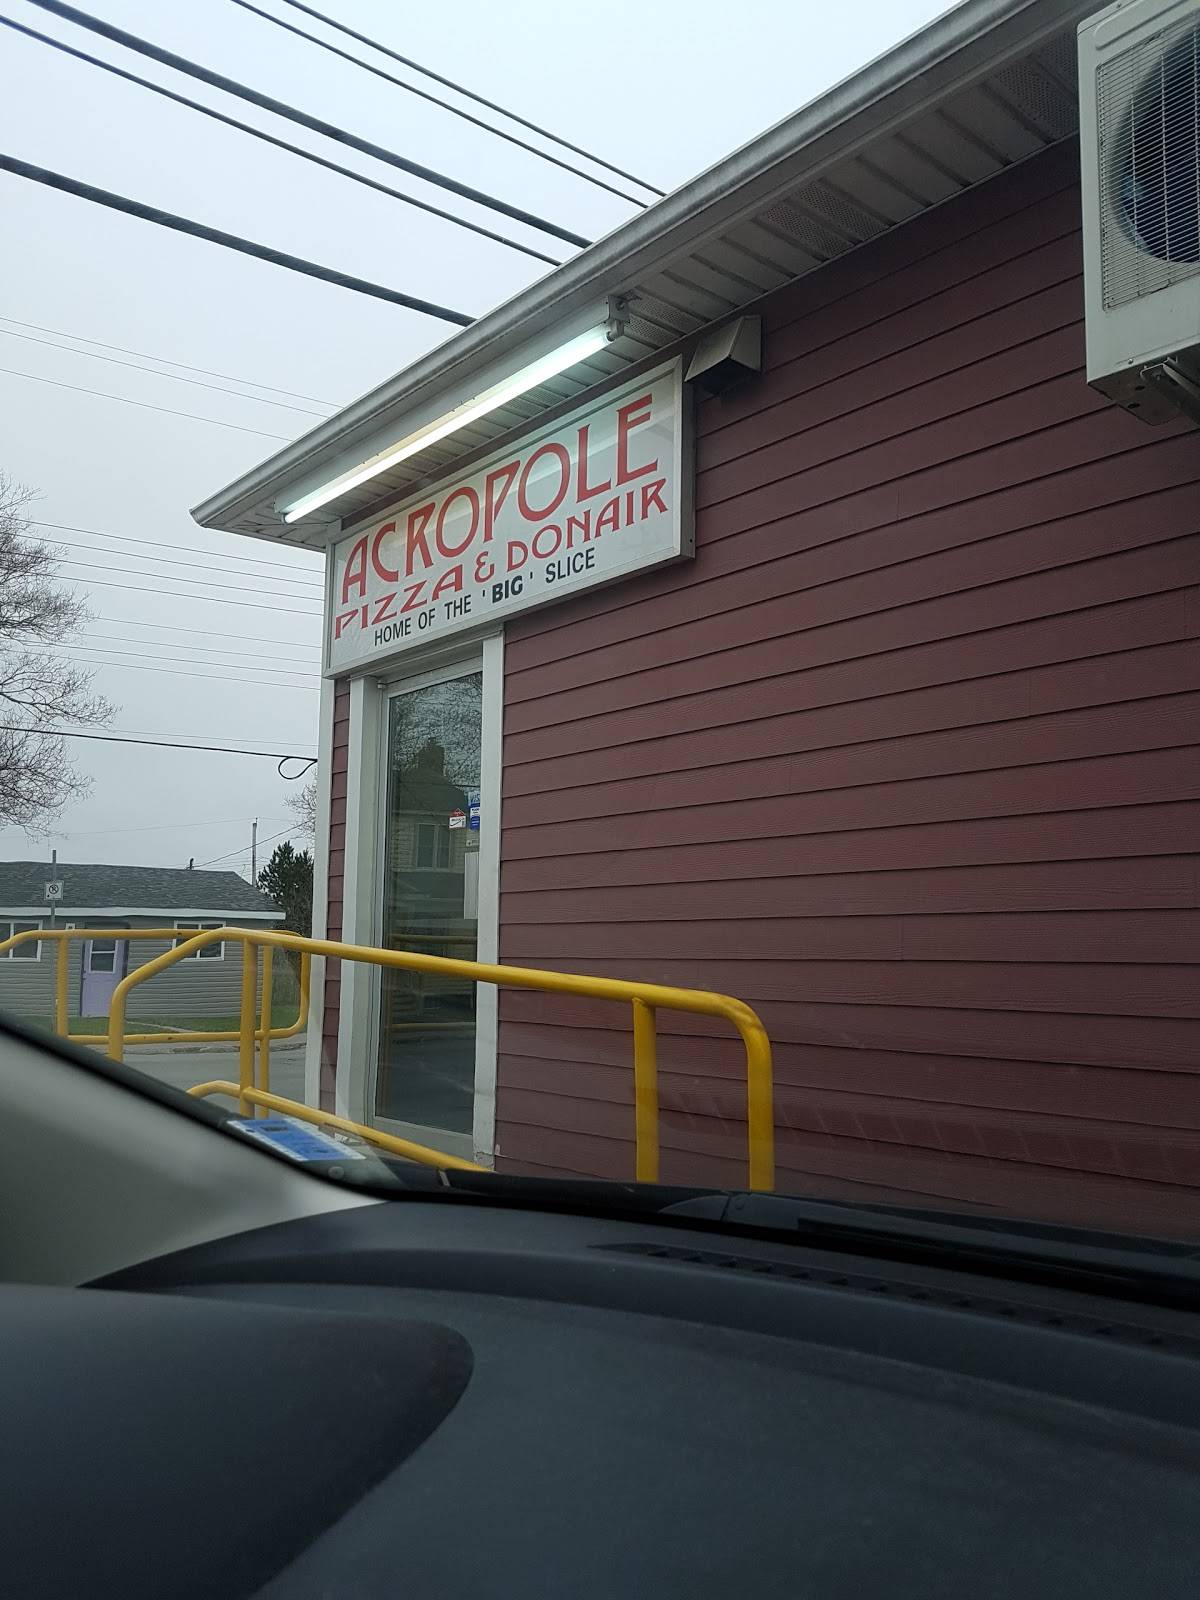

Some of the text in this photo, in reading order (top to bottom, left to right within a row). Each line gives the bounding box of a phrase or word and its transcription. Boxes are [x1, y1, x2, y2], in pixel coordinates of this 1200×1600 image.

[335, 477, 668, 639] PIZZA & DONAIR
[342, 393, 659, 604] ACROPOLE
[374, 617, 412, 647] HOME
[418, 607, 436, 630] OF
[444, 594, 472, 621] THE
[545, 547, 596, 584] SLICE
